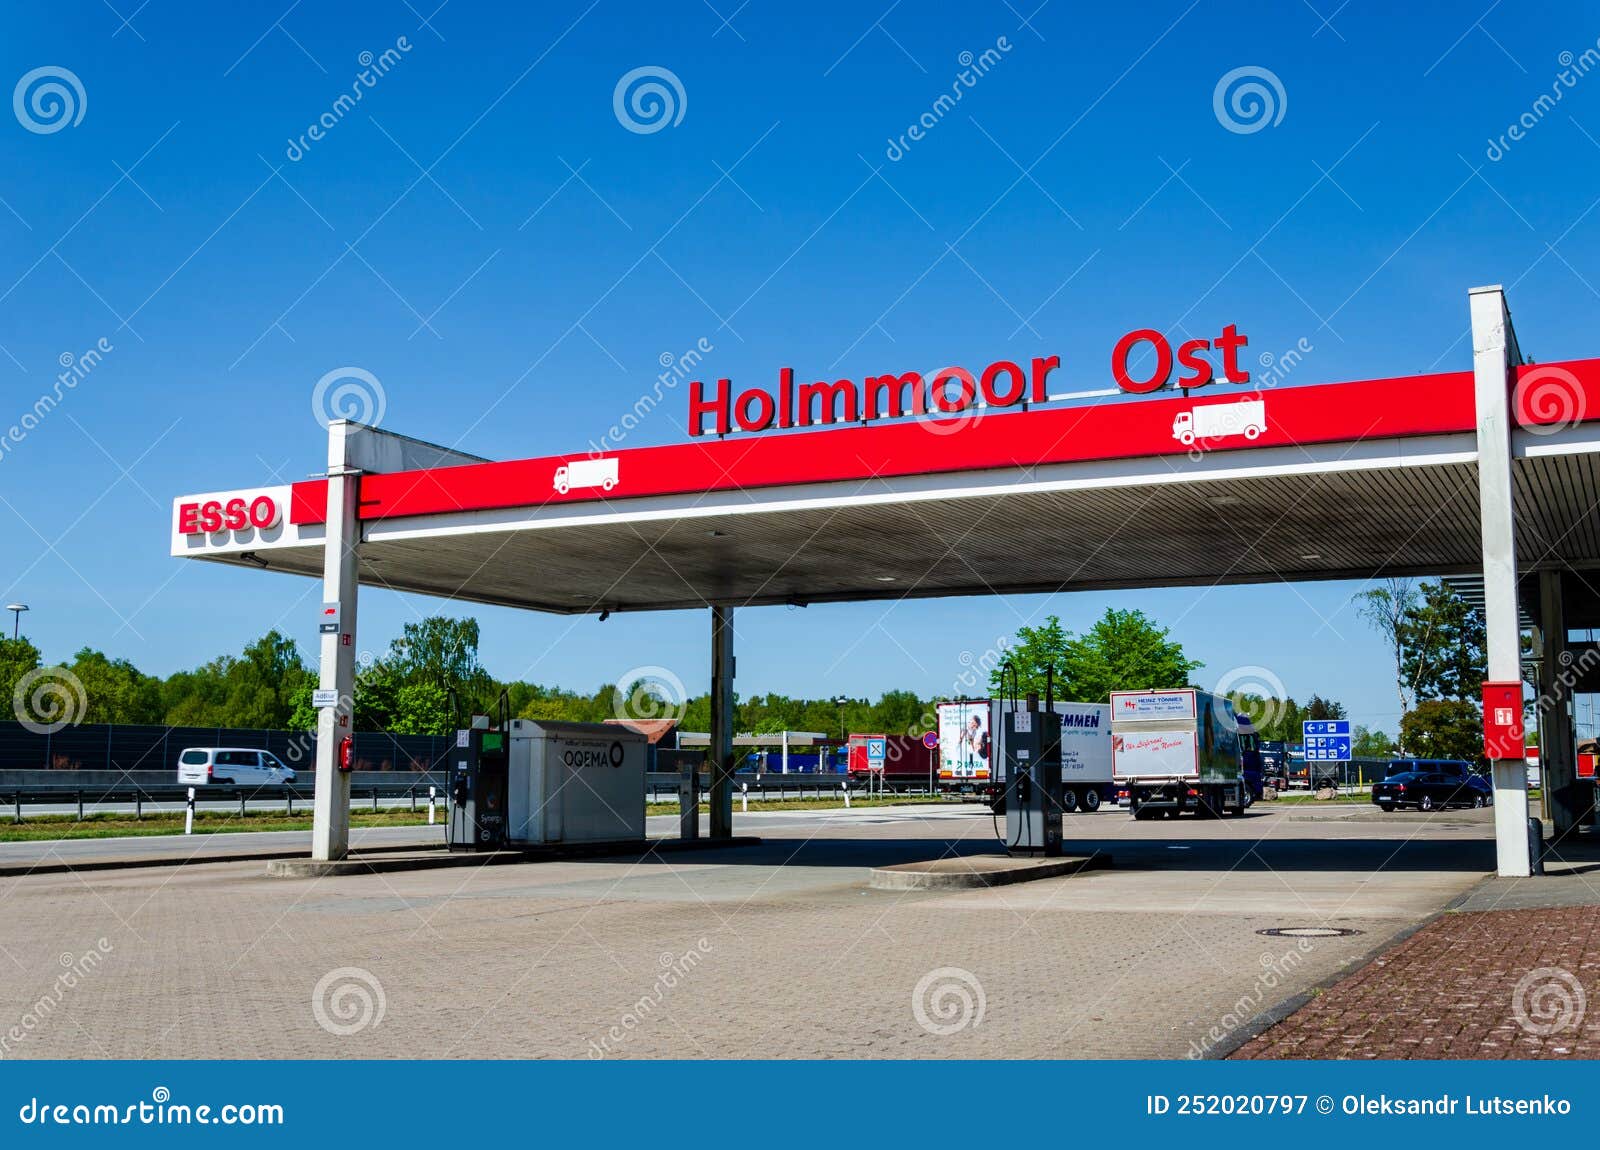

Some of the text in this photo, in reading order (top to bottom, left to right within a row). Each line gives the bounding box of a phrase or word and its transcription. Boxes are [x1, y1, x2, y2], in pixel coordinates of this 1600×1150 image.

[689, 324, 1250, 437] Holmmoor Ost
[179, 496, 277, 534] ESSO
[564, 750, 608, 768] OQEMA
